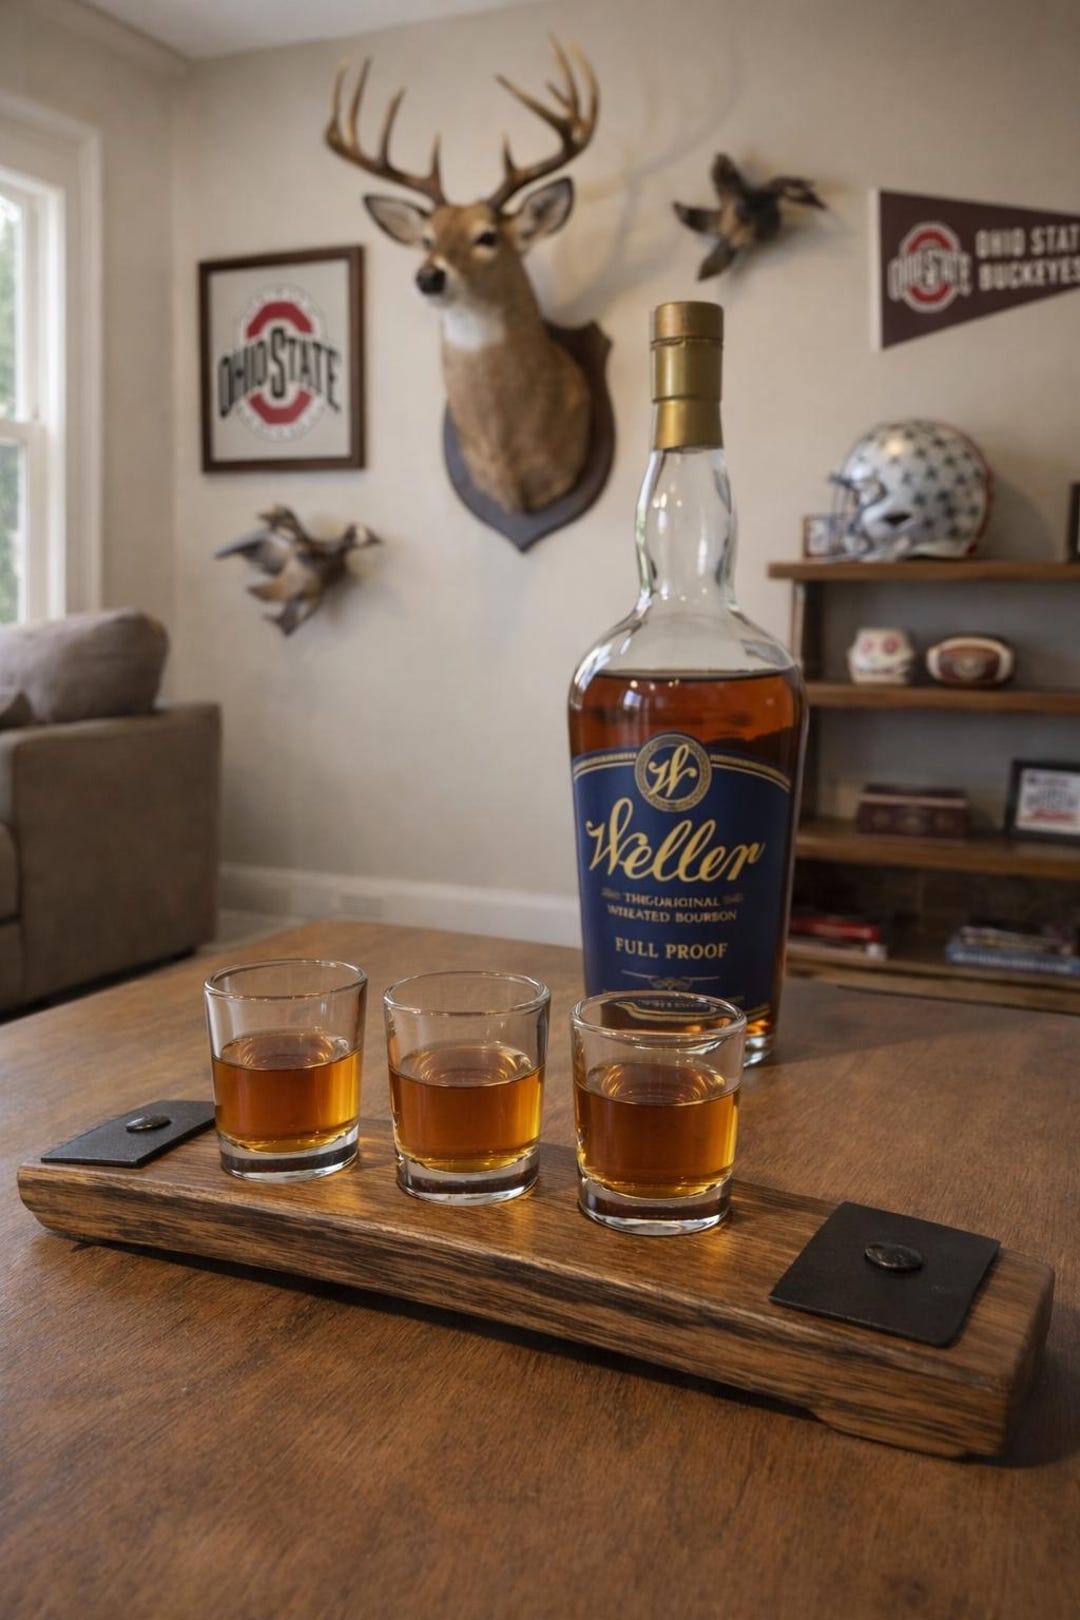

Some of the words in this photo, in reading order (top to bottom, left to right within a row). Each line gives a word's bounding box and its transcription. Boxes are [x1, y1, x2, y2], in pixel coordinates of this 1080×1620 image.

[1030, 223, 1080, 256] STAT
[585, 797, 766, 882] Weller
[615, 936, 659, 959] FULL
[665, 942, 729, 960] PROOF
